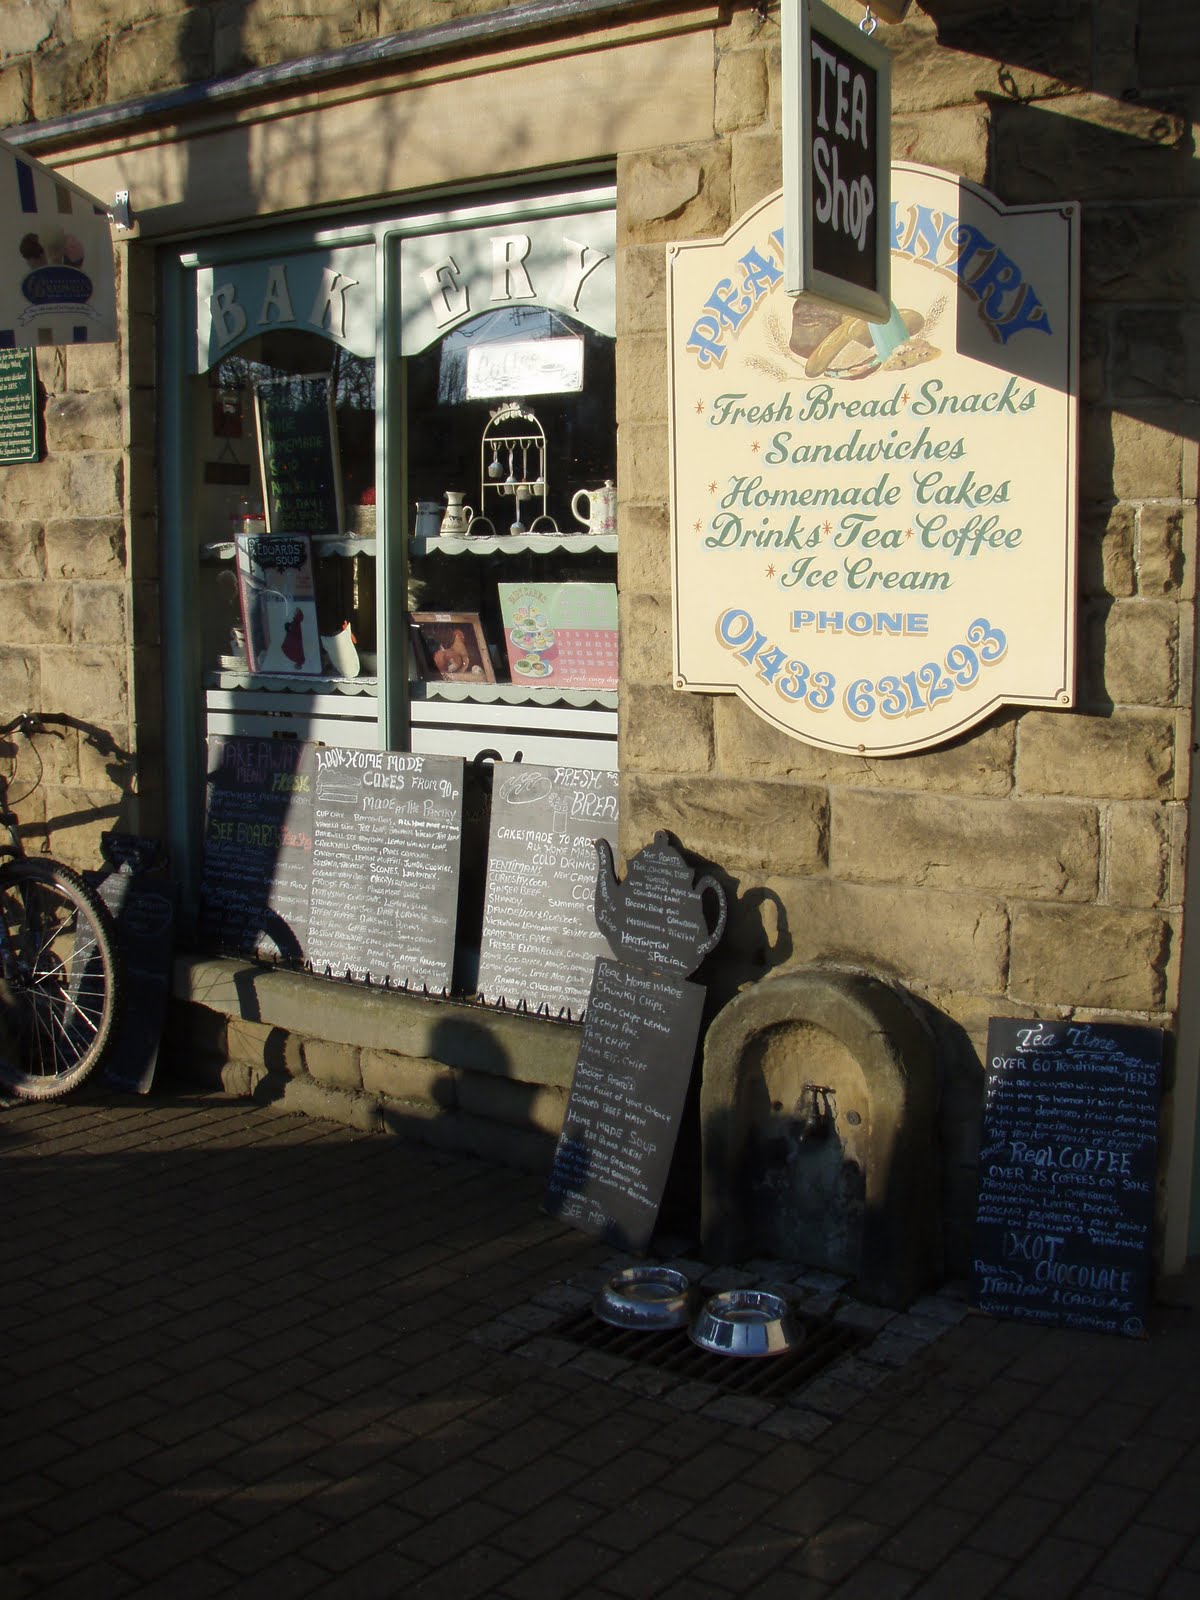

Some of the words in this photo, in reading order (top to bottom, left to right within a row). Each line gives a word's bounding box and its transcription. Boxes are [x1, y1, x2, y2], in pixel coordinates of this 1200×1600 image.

[811, 40, 868, 150] TEA
[813, 136, 874, 252] Shop
[686, 227, 784, 368] PEA
[710, 392, 792, 425] Fresh
[800, 384, 905, 422] Bread
[912, 377, 1036, 415] Snacks
[765, 427, 967, 464] Sandwiches
[721, 473, 901, 509] Homemade
[913, 470, 1011, 508] Cakes
[705, 512, 823, 549] Drinks
[834, 513, 903, 549] Tea
[915, 513, 1022, 556] Coffee
[276, 556, 299, 564] SOUP
[780, 556, 837, 588] Ice
[844, 556, 953, 591] Cream
[790, 610, 929, 637] PHONE
[715, 607, 836, 713] 01433
[843, 617, 1008, 722] 631293
[315, 747, 346, 772] LOOK
[346, 751, 383, 769] HOME
[387, 755, 425, 772] MADE
[363, 771, 405, 790] CAKES
[412, 777, 437, 791] FROM
[554, 768, 602, 790] FRESH
[316, 810, 329, 818] CUP
[363, 797, 396, 811] MADE
[406, 802, 420, 814] THE
[423, 799, 456, 821] PANTRY
[570, 791, 619, 820] BREA
[497, 827, 525, 839] CAKES
[526, 831, 553, 844] MADE
[559, 834, 570, 845] TO
[532, 854, 556, 865] COLD
[560, 857, 596, 871] DRINKS
[544, 844, 568, 857] HOME
[570, 848, 597, 860] MADE
[648, 952, 688, 969] SPECIAL
[596, 980, 636, 1005] CHUNKY
[598, 962, 622, 983] REAL
[624, 973, 651, 990] HOME
[653, 982, 684, 999] MADE
[592, 997, 611, 1012] COD
[618, 1009, 641, 1024] CHIPS
[643, 1018, 671, 1033] LEMON
[605, 1036, 631, 1050] CHIPS
[1016, 1024, 1056, 1047] Tea
[1066, 1025, 1118, 1051] Time
[621, 1057, 648, 1071] CHIPS
[992, 1056, 1027, 1070] OVER
[1032, 1059, 1051, 1072] 60
[603, 1103, 621, 1117] BEEF
[625, 1111, 647, 1127] HASH
[567, 1109, 591, 1128] HOME
[596, 1121, 623, 1139] MADE
[628, 1130, 657, 1157] SOUP
[1009, 1141, 1057, 1168] Real
[1059, 1146, 1135, 1175] COFFEE
[989, 1165, 1024, 1179] OVER
[1031, 1168, 1047, 1182] 25
[1051, 1172, 1096, 1187] COFFEES
[1099, 1177, 1115, 1187] ON
[561, 1202, 583, 1218] SEE
[1034, 1260, 1131, 1293] CHOCOLATE
